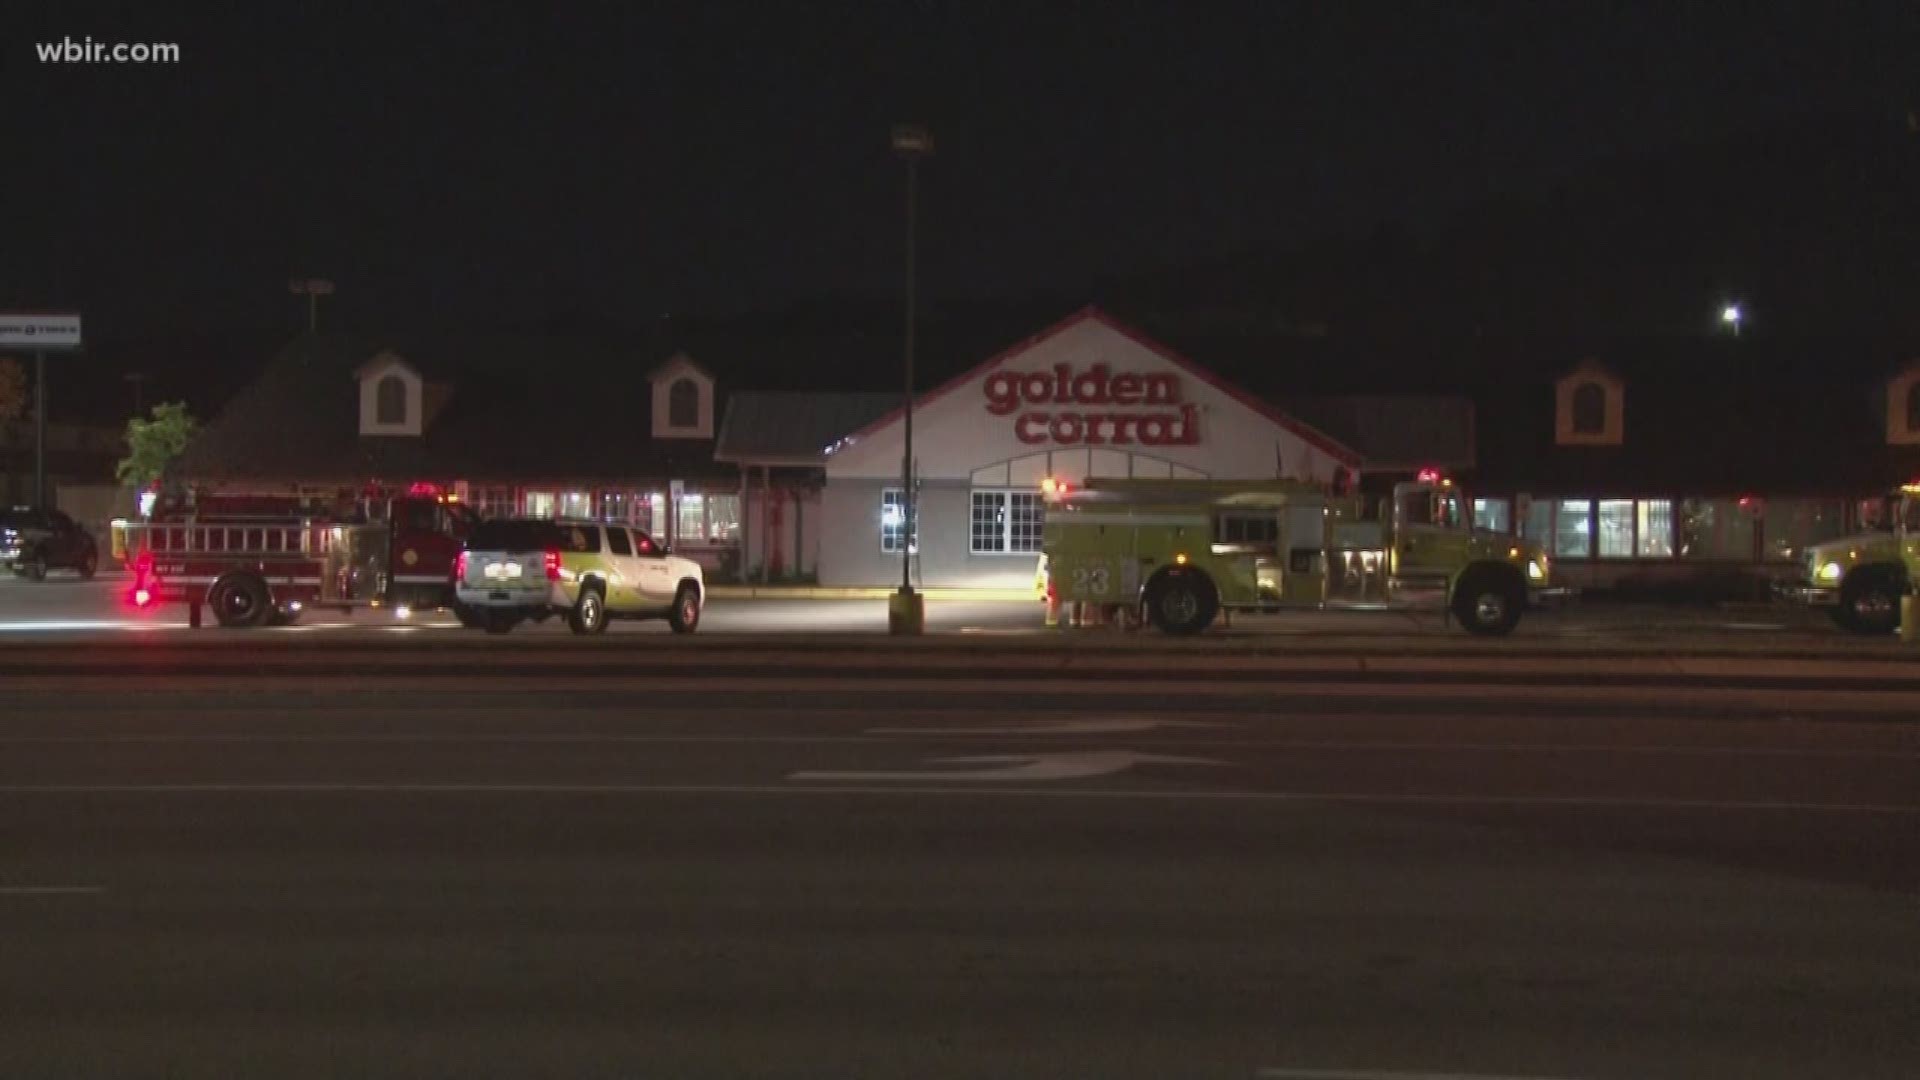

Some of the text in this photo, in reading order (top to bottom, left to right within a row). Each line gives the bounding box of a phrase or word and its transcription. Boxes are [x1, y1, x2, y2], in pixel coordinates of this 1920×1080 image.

[984, 362, 1180, 415] golden
[1015, 404, 1201, 446] corral
[1072, 569, 1111, 596] 23
